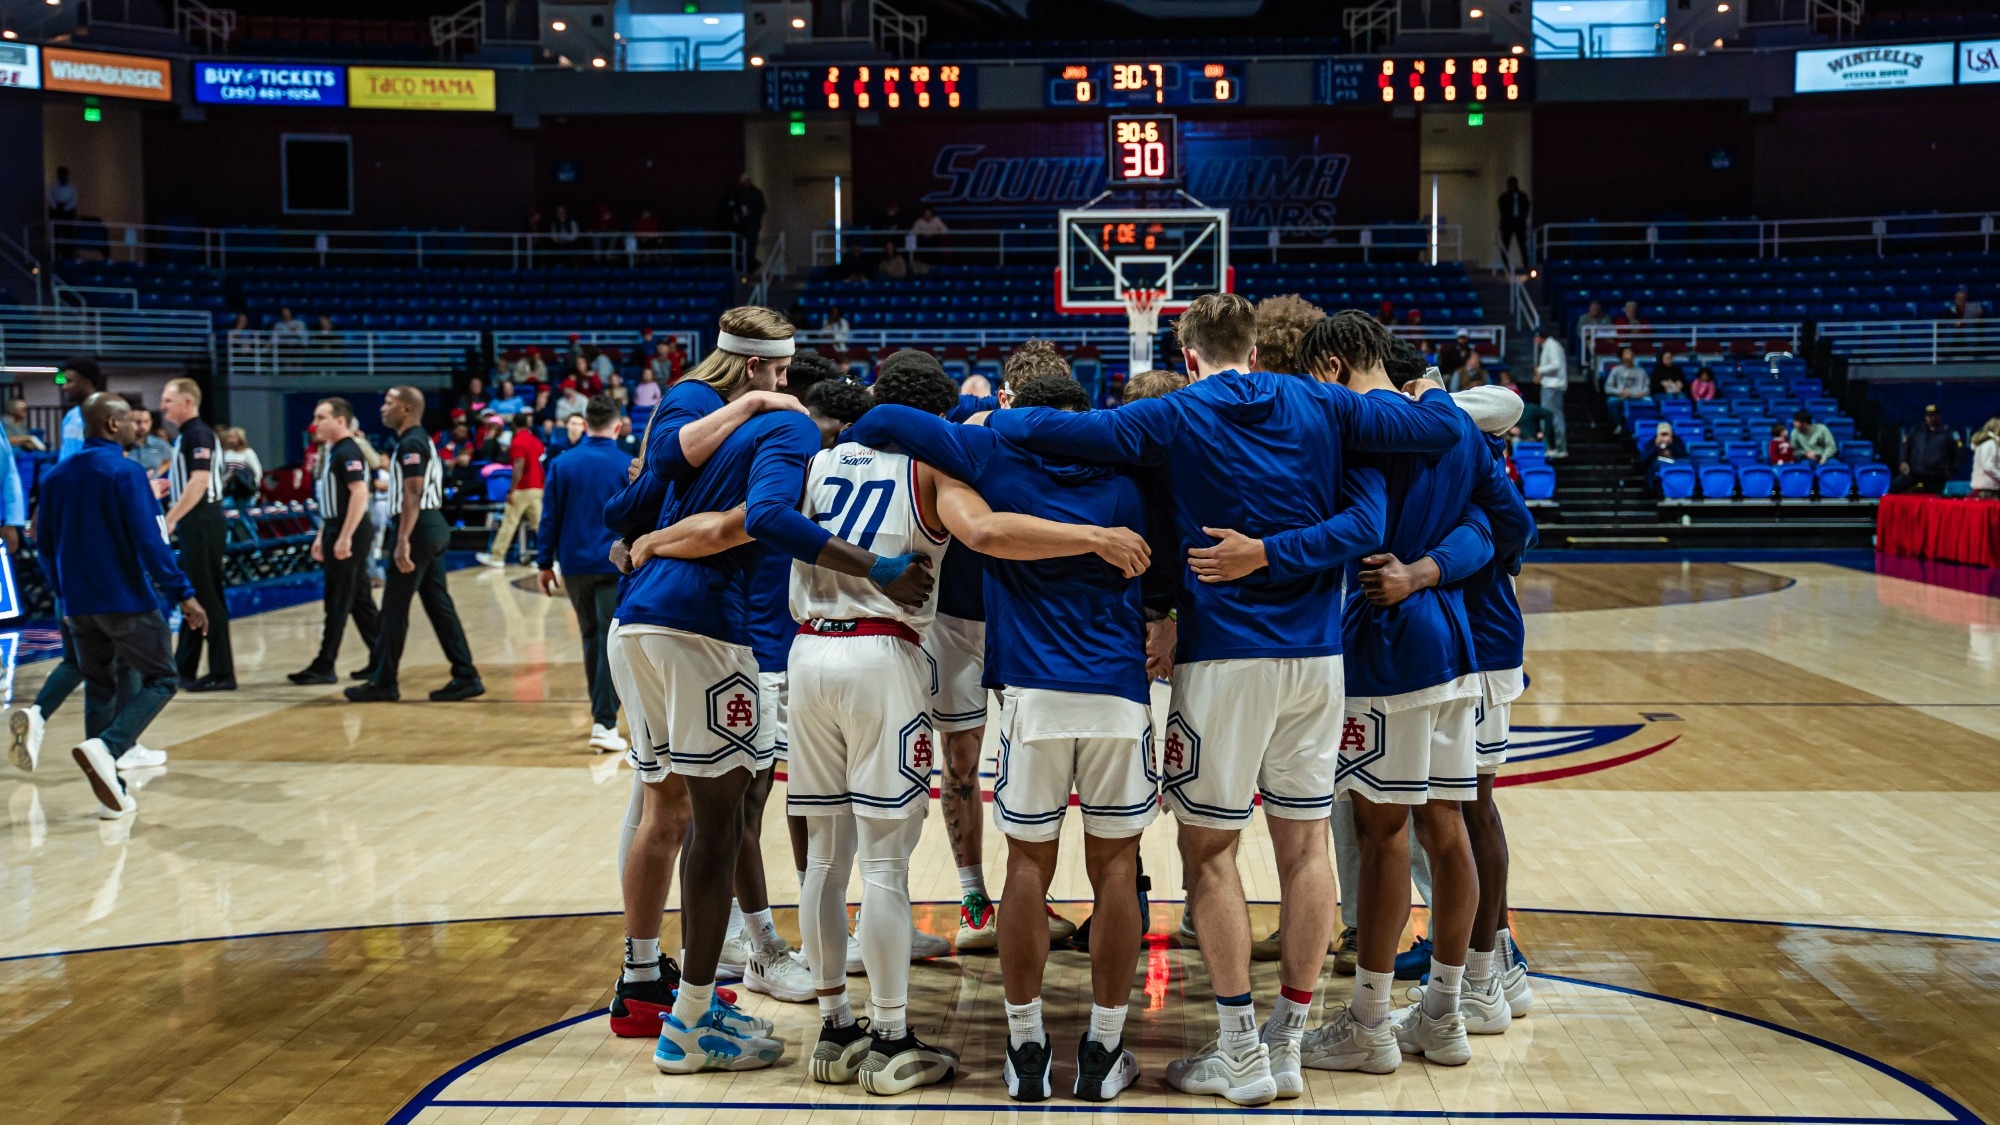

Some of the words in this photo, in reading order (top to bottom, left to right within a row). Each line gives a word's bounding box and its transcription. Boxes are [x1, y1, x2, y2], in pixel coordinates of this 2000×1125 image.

[50, 60, 163, 90] WHATABURGER
[204, 67, 243, 84] BUY
[261, 69, 336, 86] TICKETS
[828, 66, 840, 83] 2
[858, 66, 870, 83] 3
[909, 66, 930, 82] 20
[940, 65, 960, 82] 22
[1113, 64, 1163, 90] 30.7
[1382, 60, 1394, 76] 0
[1413, 60, 1425, 75] 4
[1444, 58, 1456, 75] 6
[1498, 58, 1519, 74] 23
[422, 78, 474, 95] MAMA
[1076, 81, 1091, 102] 0
[1156, 89, 1163, 104] 1
[1215, 79, 1230, 100] 0
[1382, 86, 1394, 102] 0
[1413, 85, 1425, 102] 0
[1444, 85, 1456, 101] 0
[1475, 84, 1487, 101] 0
[1506, 84, 1519, 100] 0
[1116, 121, 1160, 144] 30.6
[1123, 142, 1165, 177] 30
[921, 144, 1103, 202] SOUTH
[839, 455, 874, 467] SOUTH
[810, 477, 897, 552] 20
